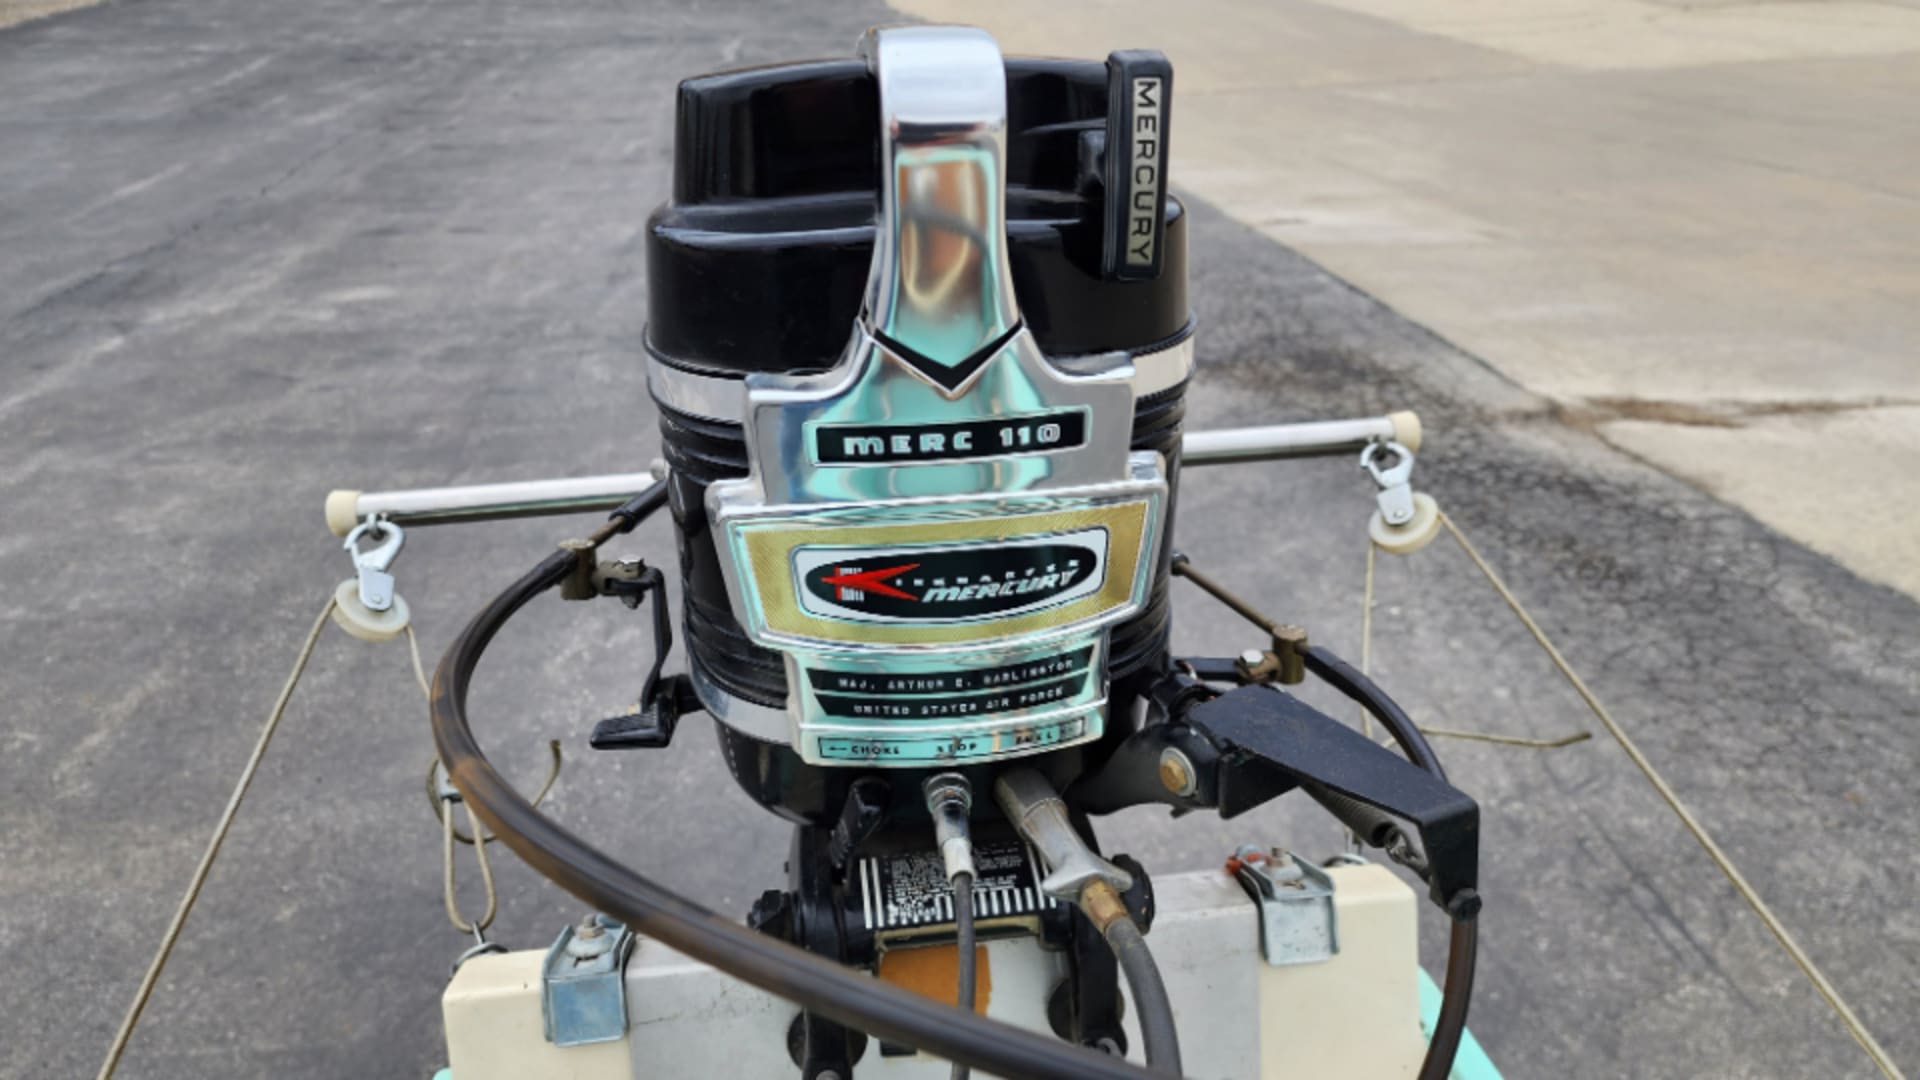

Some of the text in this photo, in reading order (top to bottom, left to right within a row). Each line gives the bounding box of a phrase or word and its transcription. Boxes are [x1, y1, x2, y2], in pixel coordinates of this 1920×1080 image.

[1131, 80, 1157, 261] MERCURY
[843, 423, 1061, 456] MERC 110
[922, 567, 1080, 603] MERCURY
[853, 686, 1064, 716] UNITED STATES AIR FORCE
